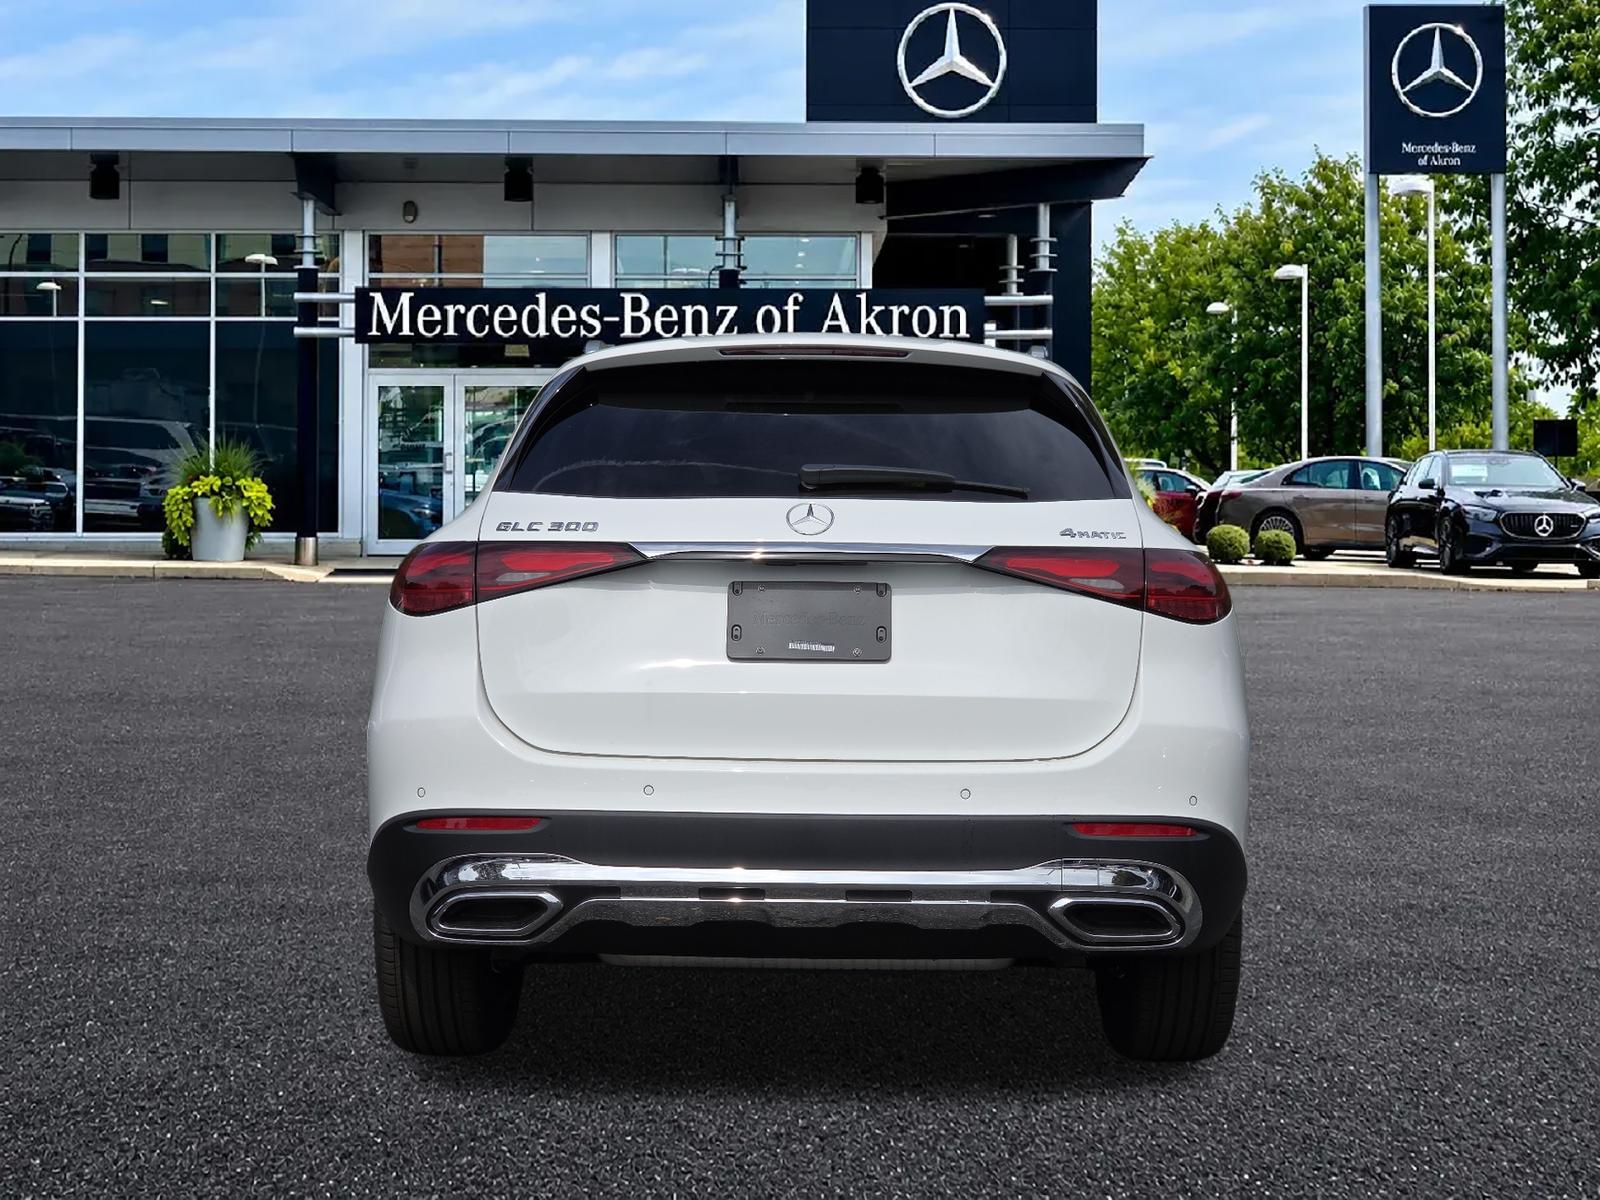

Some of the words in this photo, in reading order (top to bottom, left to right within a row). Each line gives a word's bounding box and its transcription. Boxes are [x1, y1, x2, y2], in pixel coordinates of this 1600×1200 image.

[1401, 141, 1477, 154] Mercedes-Benz
[1417, 154, 1428, 166] of
[1430, 154, 1461, 166] Akron
[367, 291, 738, 338] Mercedes-Benz
[755, 291, 804, 334] of
[821, 291, 970, 338] Akron
[495, 521, 544, 532] GLC
[547, 521, 599, 532] 300
[1059, 527, 1127, 539] 4MATIC
